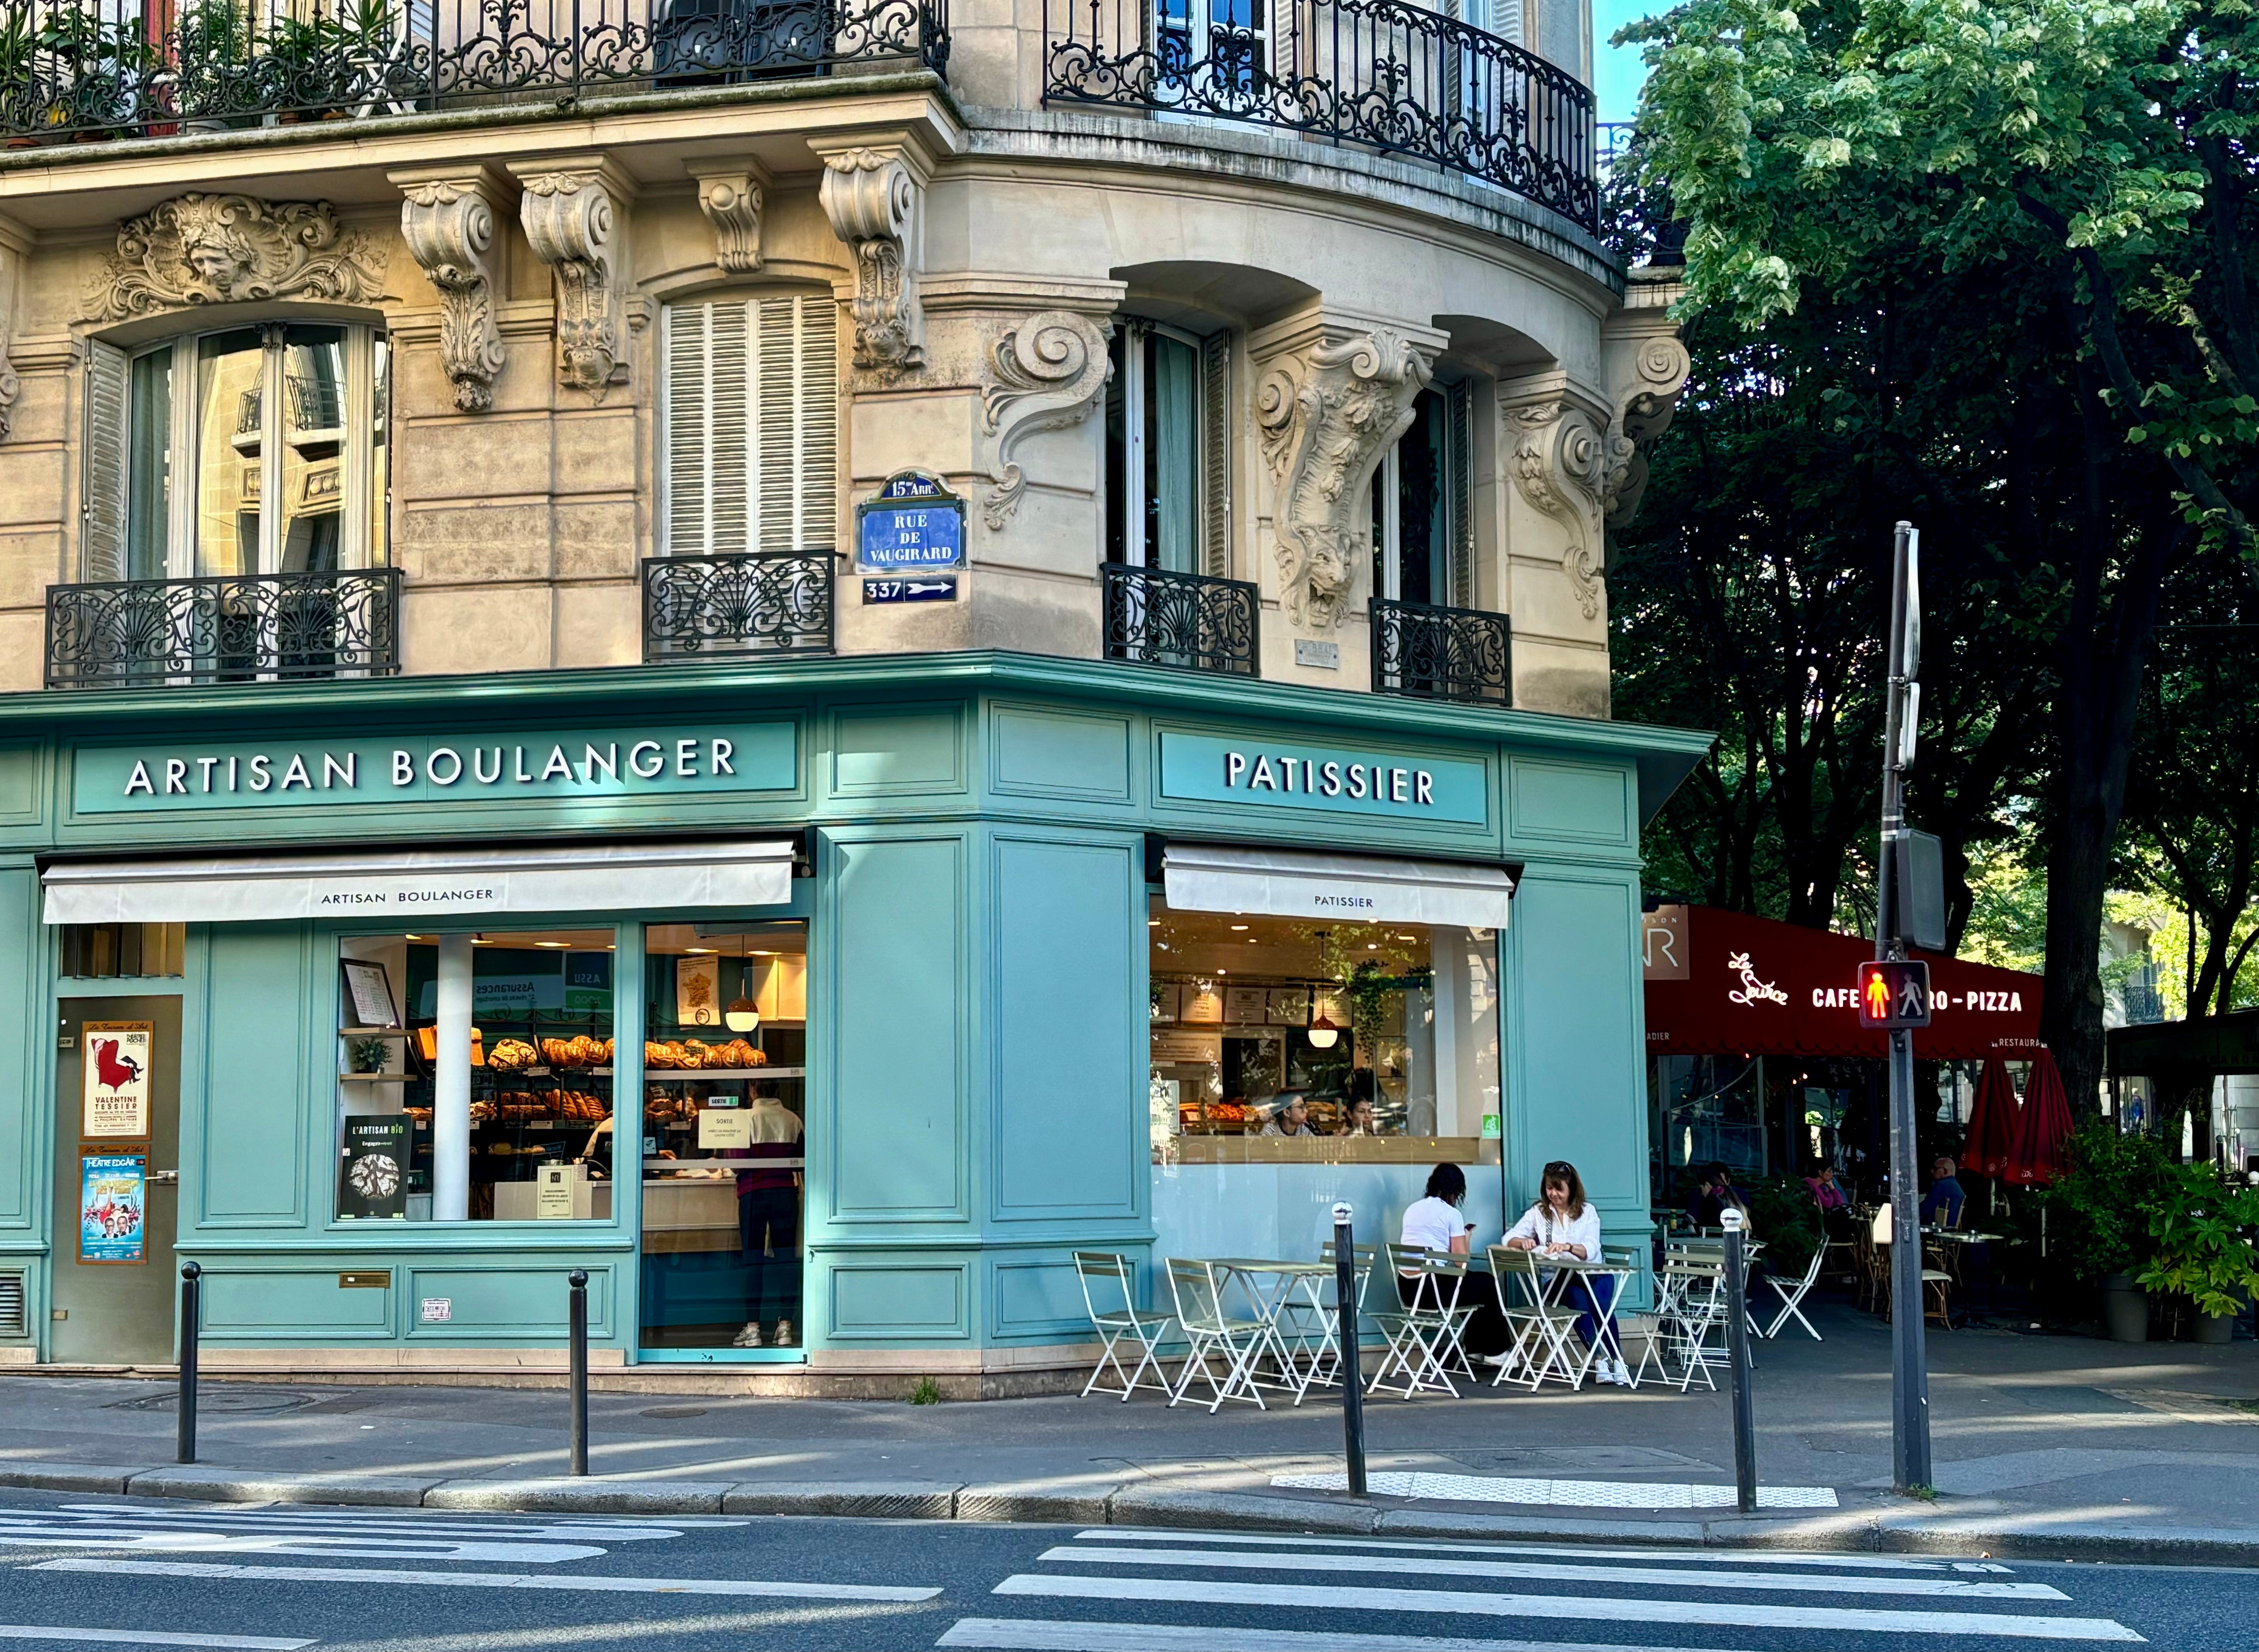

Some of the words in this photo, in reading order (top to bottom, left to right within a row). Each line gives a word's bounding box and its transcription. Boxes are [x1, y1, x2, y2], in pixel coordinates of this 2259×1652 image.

[895, 515, 927, 528] RUE
[900, 532, 920, 544] DE
[871, 547, 952, 562] VAUGIRARD
[867, 582, 901, 598] 337
[124, 752, 356, 795] ARTISAN
[392, 738, 734, 785] BOULANGER
[1225, 751, 1434, 804] PATISSIER
[321, 893, 386, 904] ARTISAN
[398, 889, 493, 902] BOULANGER
[1315, 895, 1374, 908] PATISSIER
[1728, 951, 1754, 969] La
[1729, 969, 1788, 1007] Source
[1812, 988, 1860, 1008] CAFE
[1968, 992, 2022, 1012] PIZZA
[1646, 1032, 1669, 1041] ADIER
[1999, 1038, 2040, 1047] RESTAURA
[353, 1126, 388, 1134] L'ARTISAN
